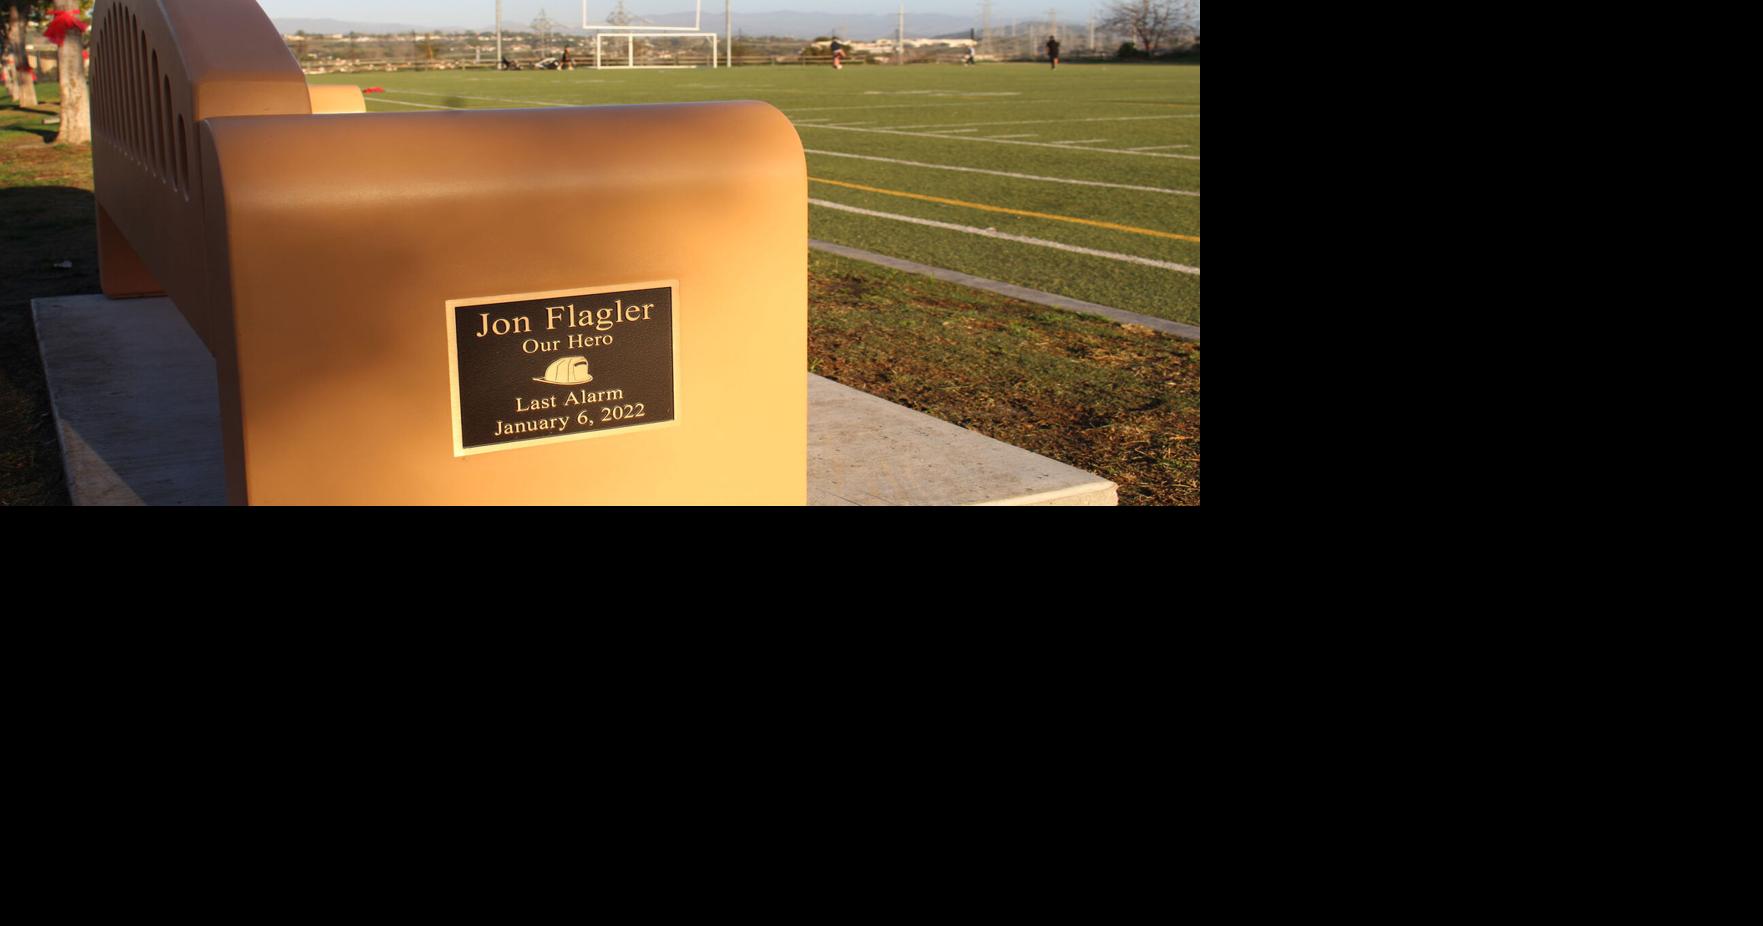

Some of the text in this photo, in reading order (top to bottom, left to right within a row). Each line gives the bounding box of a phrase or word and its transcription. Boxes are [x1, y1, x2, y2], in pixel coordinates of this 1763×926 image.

[476, 300, 655, 338] Jon Flagler
[522, 333, 613, 354] Our Hero
[516, 388, 624, 412] Last Alarm
[494, 403, 646, 436] January 6, 2022
